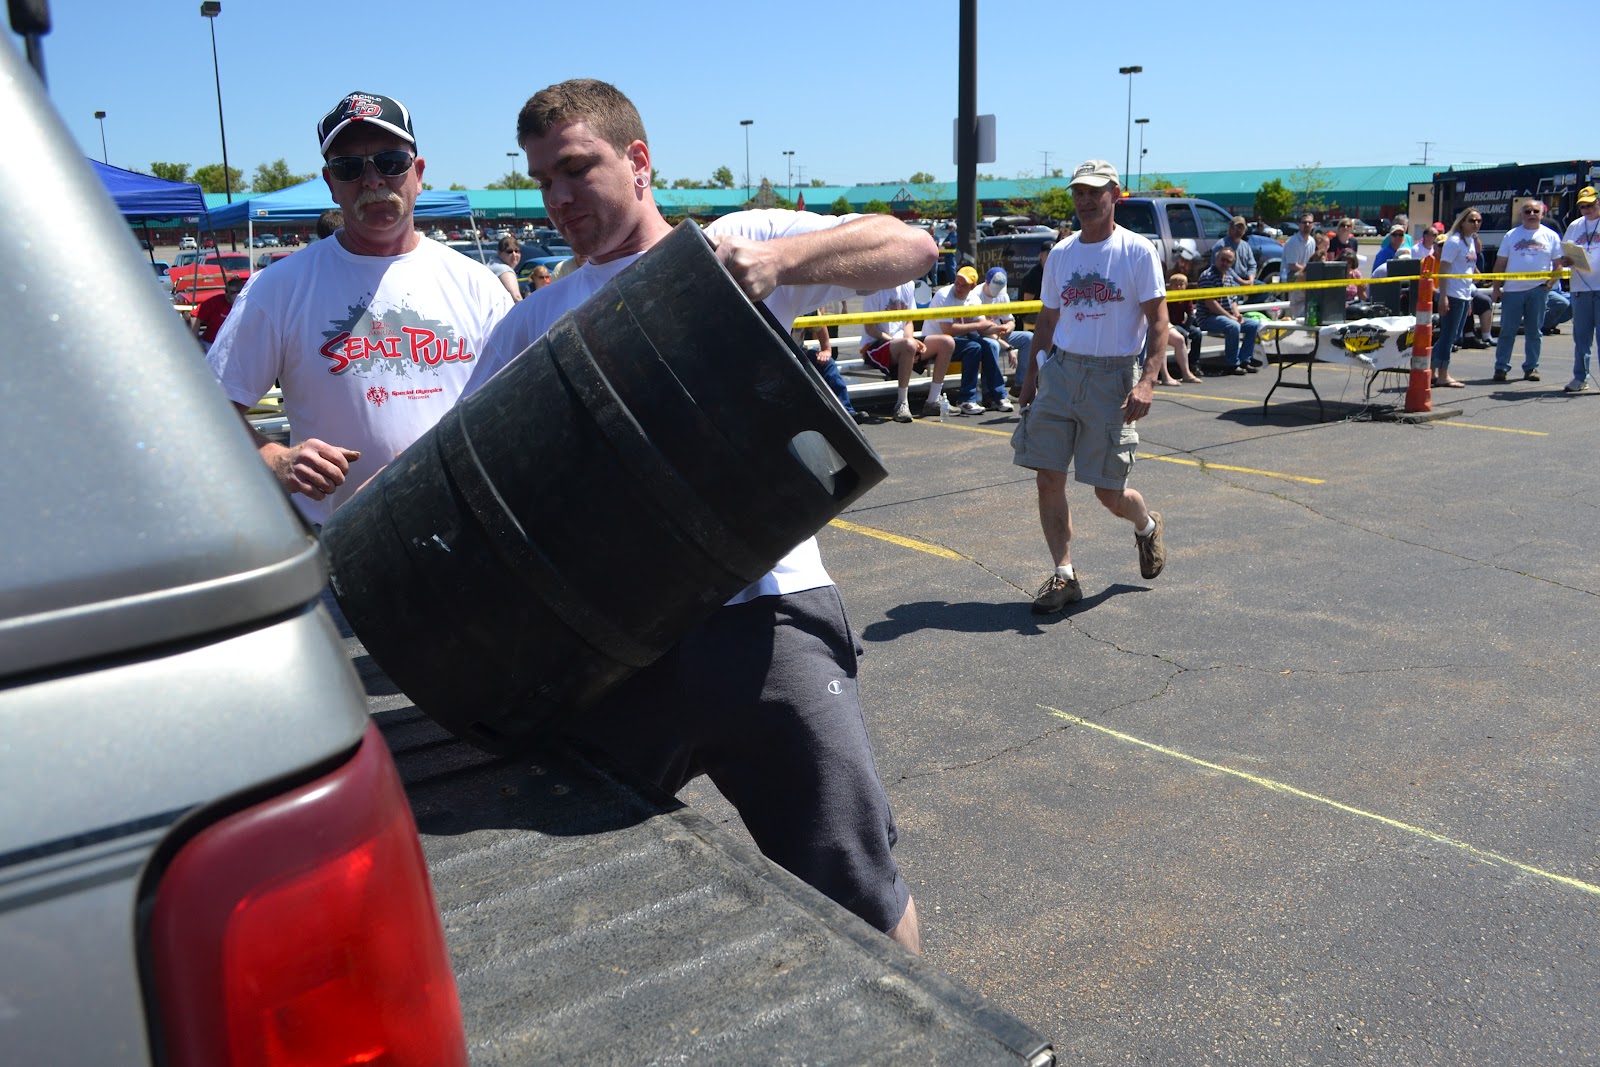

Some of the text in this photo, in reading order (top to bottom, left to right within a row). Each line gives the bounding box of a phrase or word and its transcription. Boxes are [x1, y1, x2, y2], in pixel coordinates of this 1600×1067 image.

[1463, 190, 1502, 202] ROTHSCHILD
[1060, 281, 1125, 308] SEMI PULL
[319, 326, 476, 374] SEMI PULL
[415, 387, 443, 395] Olympics
